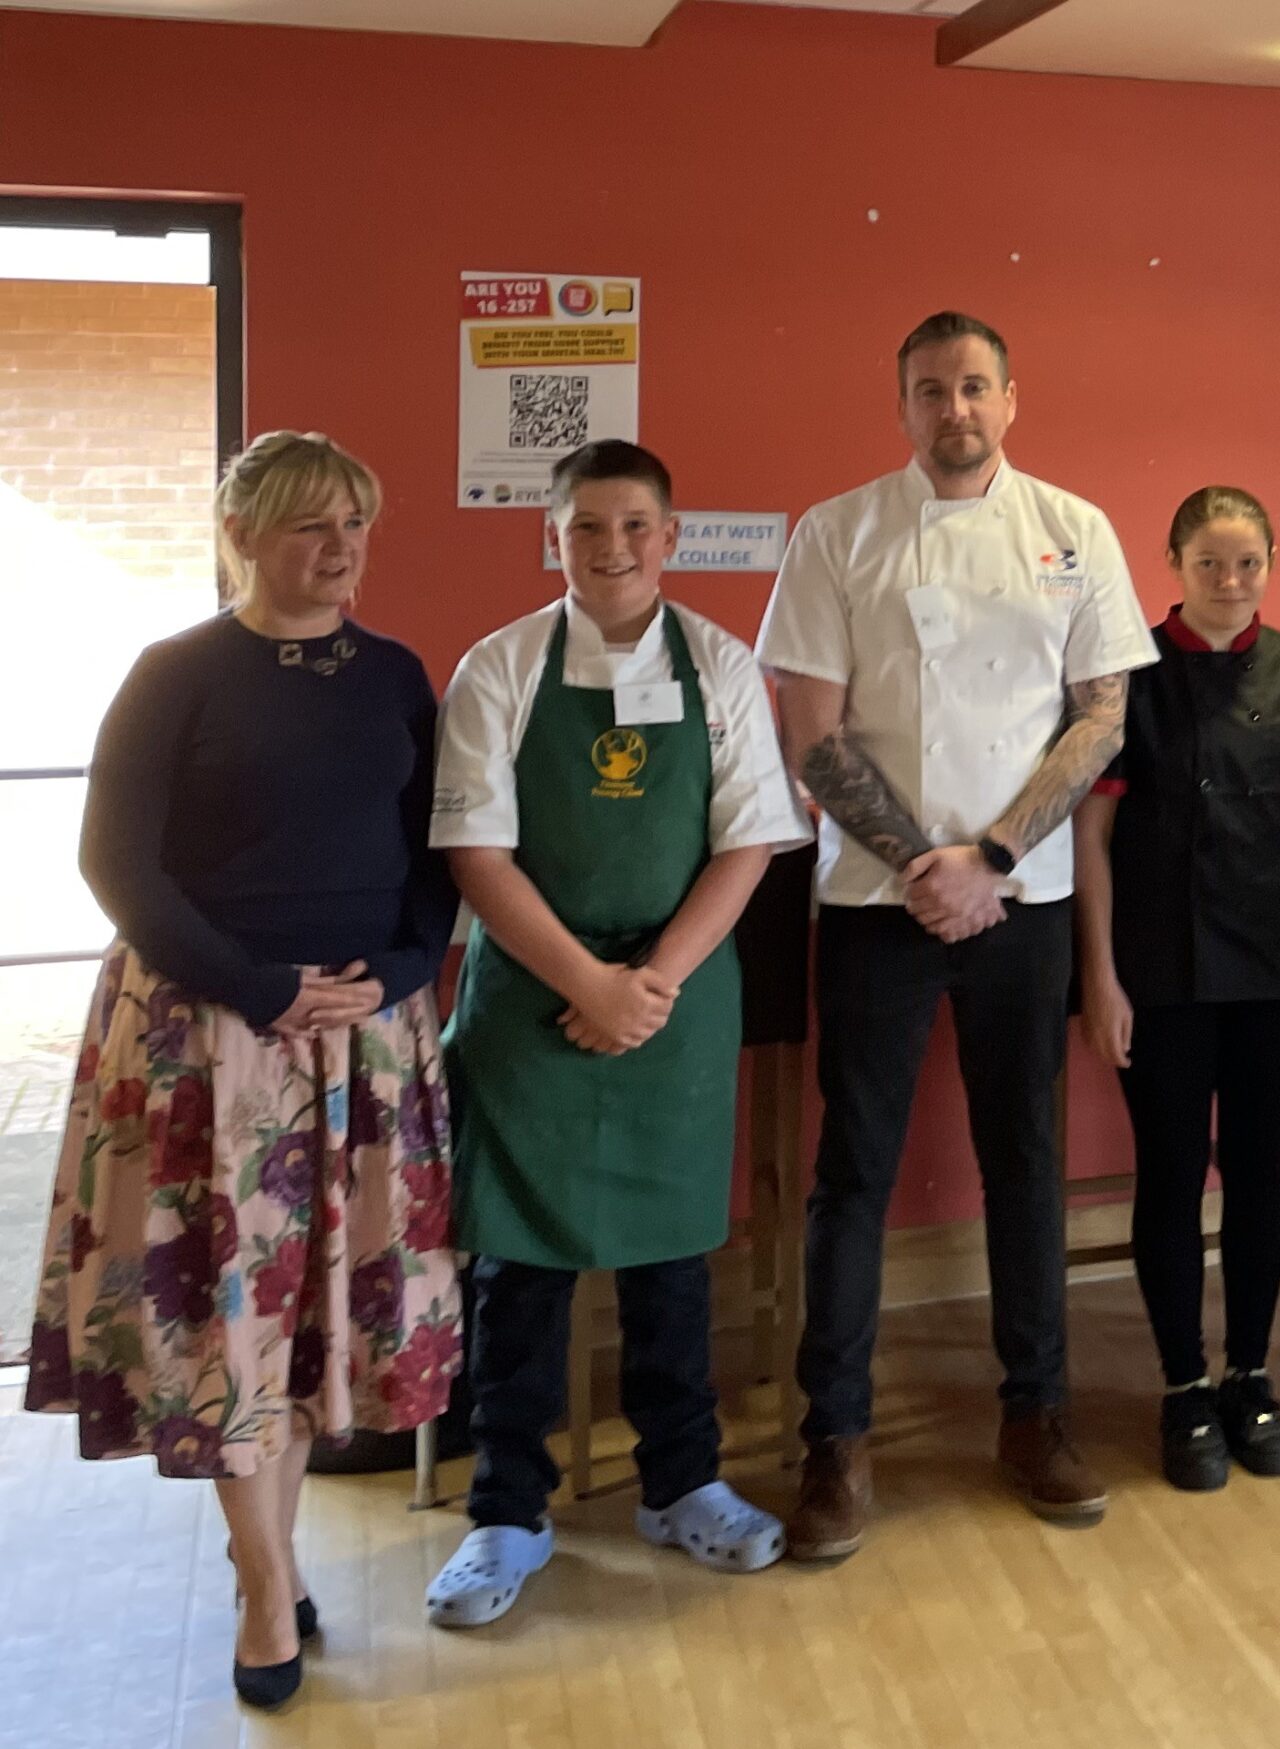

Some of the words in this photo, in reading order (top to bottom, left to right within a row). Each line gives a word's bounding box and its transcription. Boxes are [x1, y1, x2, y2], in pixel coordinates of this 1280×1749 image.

[465, 283, 498, 296] ARE
[502, 281, 541, 295] YOU
[477, 300, 497, 314] 16
[701, 524, 723, 538] AT
[727, 525, 775, 539] WEST
[679, 550, 752, 564] COLLEGE
